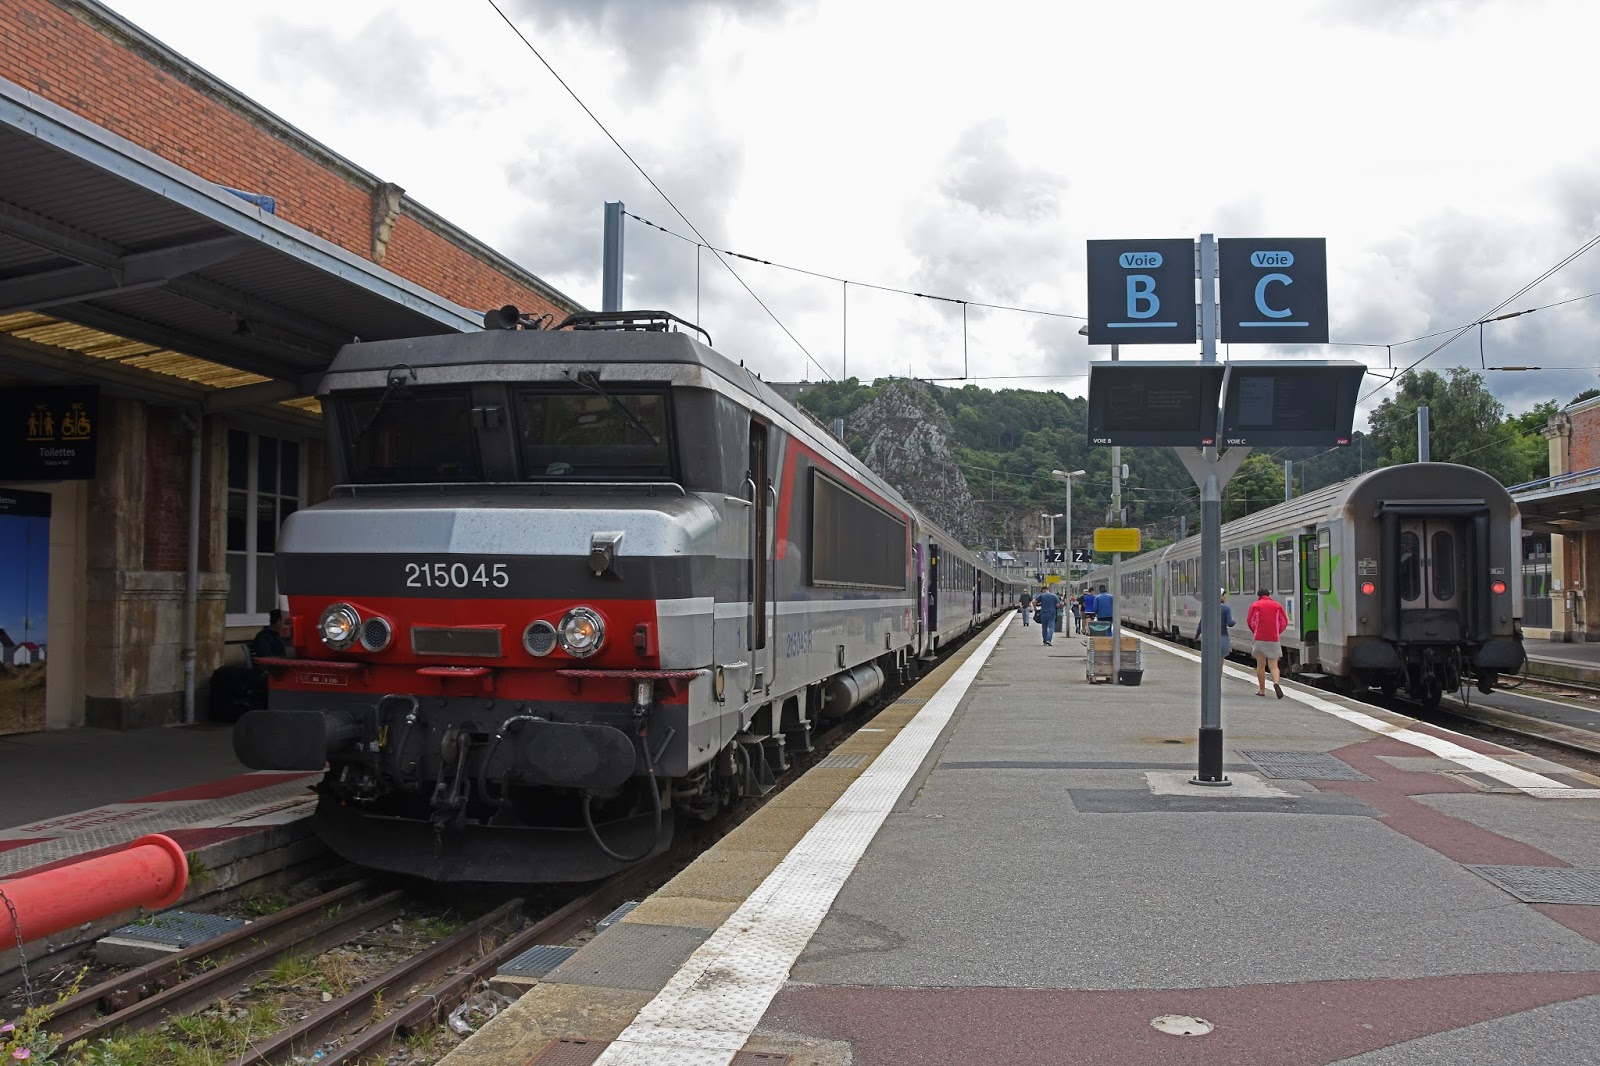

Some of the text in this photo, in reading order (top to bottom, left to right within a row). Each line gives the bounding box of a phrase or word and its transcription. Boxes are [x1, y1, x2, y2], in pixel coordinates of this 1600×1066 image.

[1124, 254, 1157, 266] Voie
[1256, 253, 1288, 265] Voie
[1126, 274, 1160, 319] B
[1254, 273, 1294, 319] C
[39, 447, 76, 457] Toilettes
[1054, 552, 1062, 562] Z
[1075, 552, 1083, 562] Z
[405, 562, 509, 588] 215045
[20, 809, 117, 832] DESCENTE
[64, 807, 160, 831] INTERDITE
